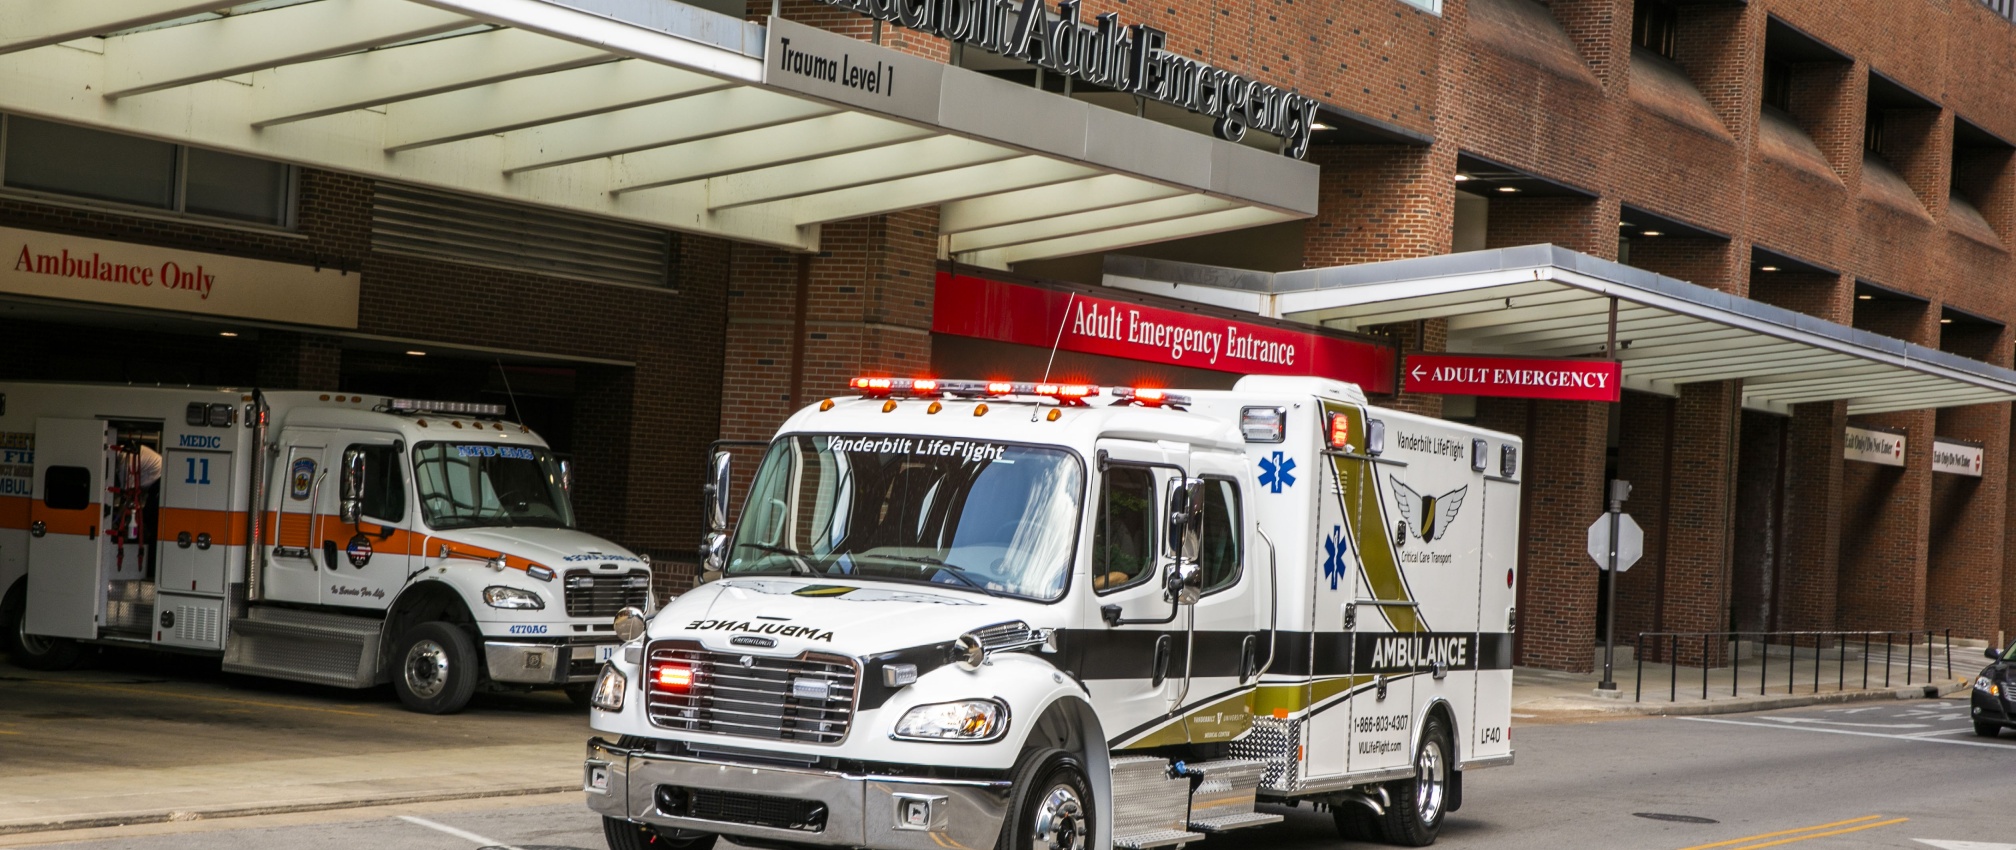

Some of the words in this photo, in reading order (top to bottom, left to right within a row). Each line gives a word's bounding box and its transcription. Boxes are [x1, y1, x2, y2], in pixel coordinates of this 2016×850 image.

[781, 37, 837, 83] Trauma
[842, 54, 882, 94] Level
[887, 65, 893, 97] 1
[1012, 0, 1132, 92] Adult
[1130, 24, 1320, 159] Emergency
[14, 243, 153, 286] Ambulance
[160, 261, 215, 300] Only
[1072, 300, 1123, 340] Adult
[1128, 309, 1222, 364] Emergency
[1226, 326, 1295, 366] Entrance
[1431, 367, 1489, 383] ADULT
[1493, 369, 1609, 388] EMERGENCY
[180, 434, 221, 448] MEDIC
[457, 445, 496, 458] NFD
[498, 446, 534, 460] EMS
[827, 436, 911, 454] Vanderbilt
[915, 439, 1005, 461] LifeFlight
[1397, 431, 1432, 453] Vanderbilt
[1433, 438, 1464, 461] LifeFlight
[185, 457, 210, 485] 11
[1401, 550, 1418, 563] Critical
[1420, 551, 1430, 563] Care
[1431, 551, 1452, 566] Transport
[509, 625, 547, 634] 4770AG
[1371, 637, 1467, 668] AMBULANCE
[1354, 715, 1408, 733] 1-866-803-4307
[1481, 727, 1501, 744] LF40
[1358, 740, 1402, 755] VULifeFlight.com
